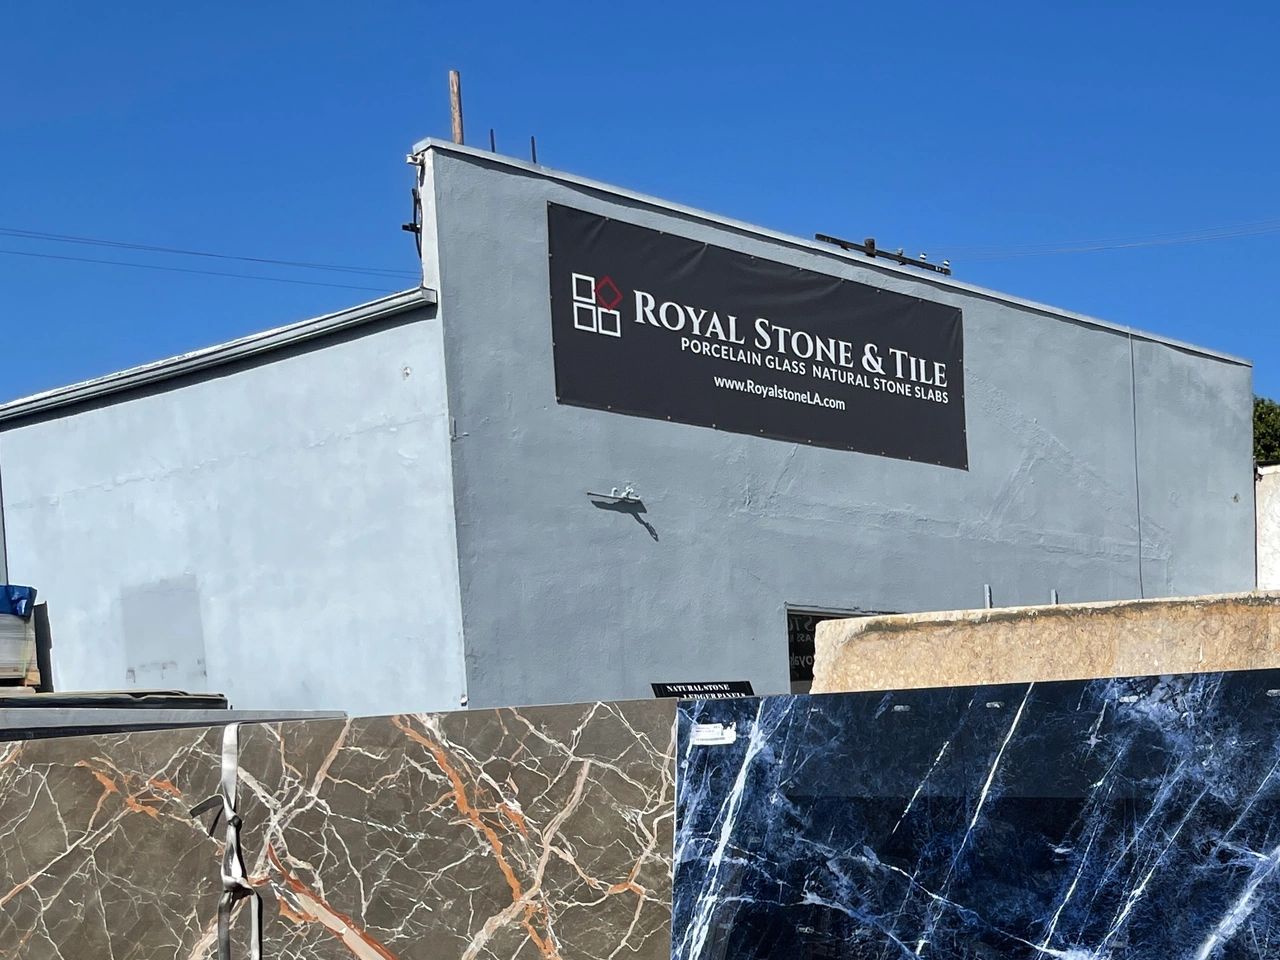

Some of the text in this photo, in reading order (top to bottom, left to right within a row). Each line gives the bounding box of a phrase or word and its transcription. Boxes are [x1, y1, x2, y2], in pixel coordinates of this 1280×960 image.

[633, 289, 948, 388] ROYAL STONE & TILE
[681, 337, 949, 404] PORCELAIN GLASS NATURAL STONE SLABS
[714, 375, 846, 411] www.RoyalstoneLA.com
